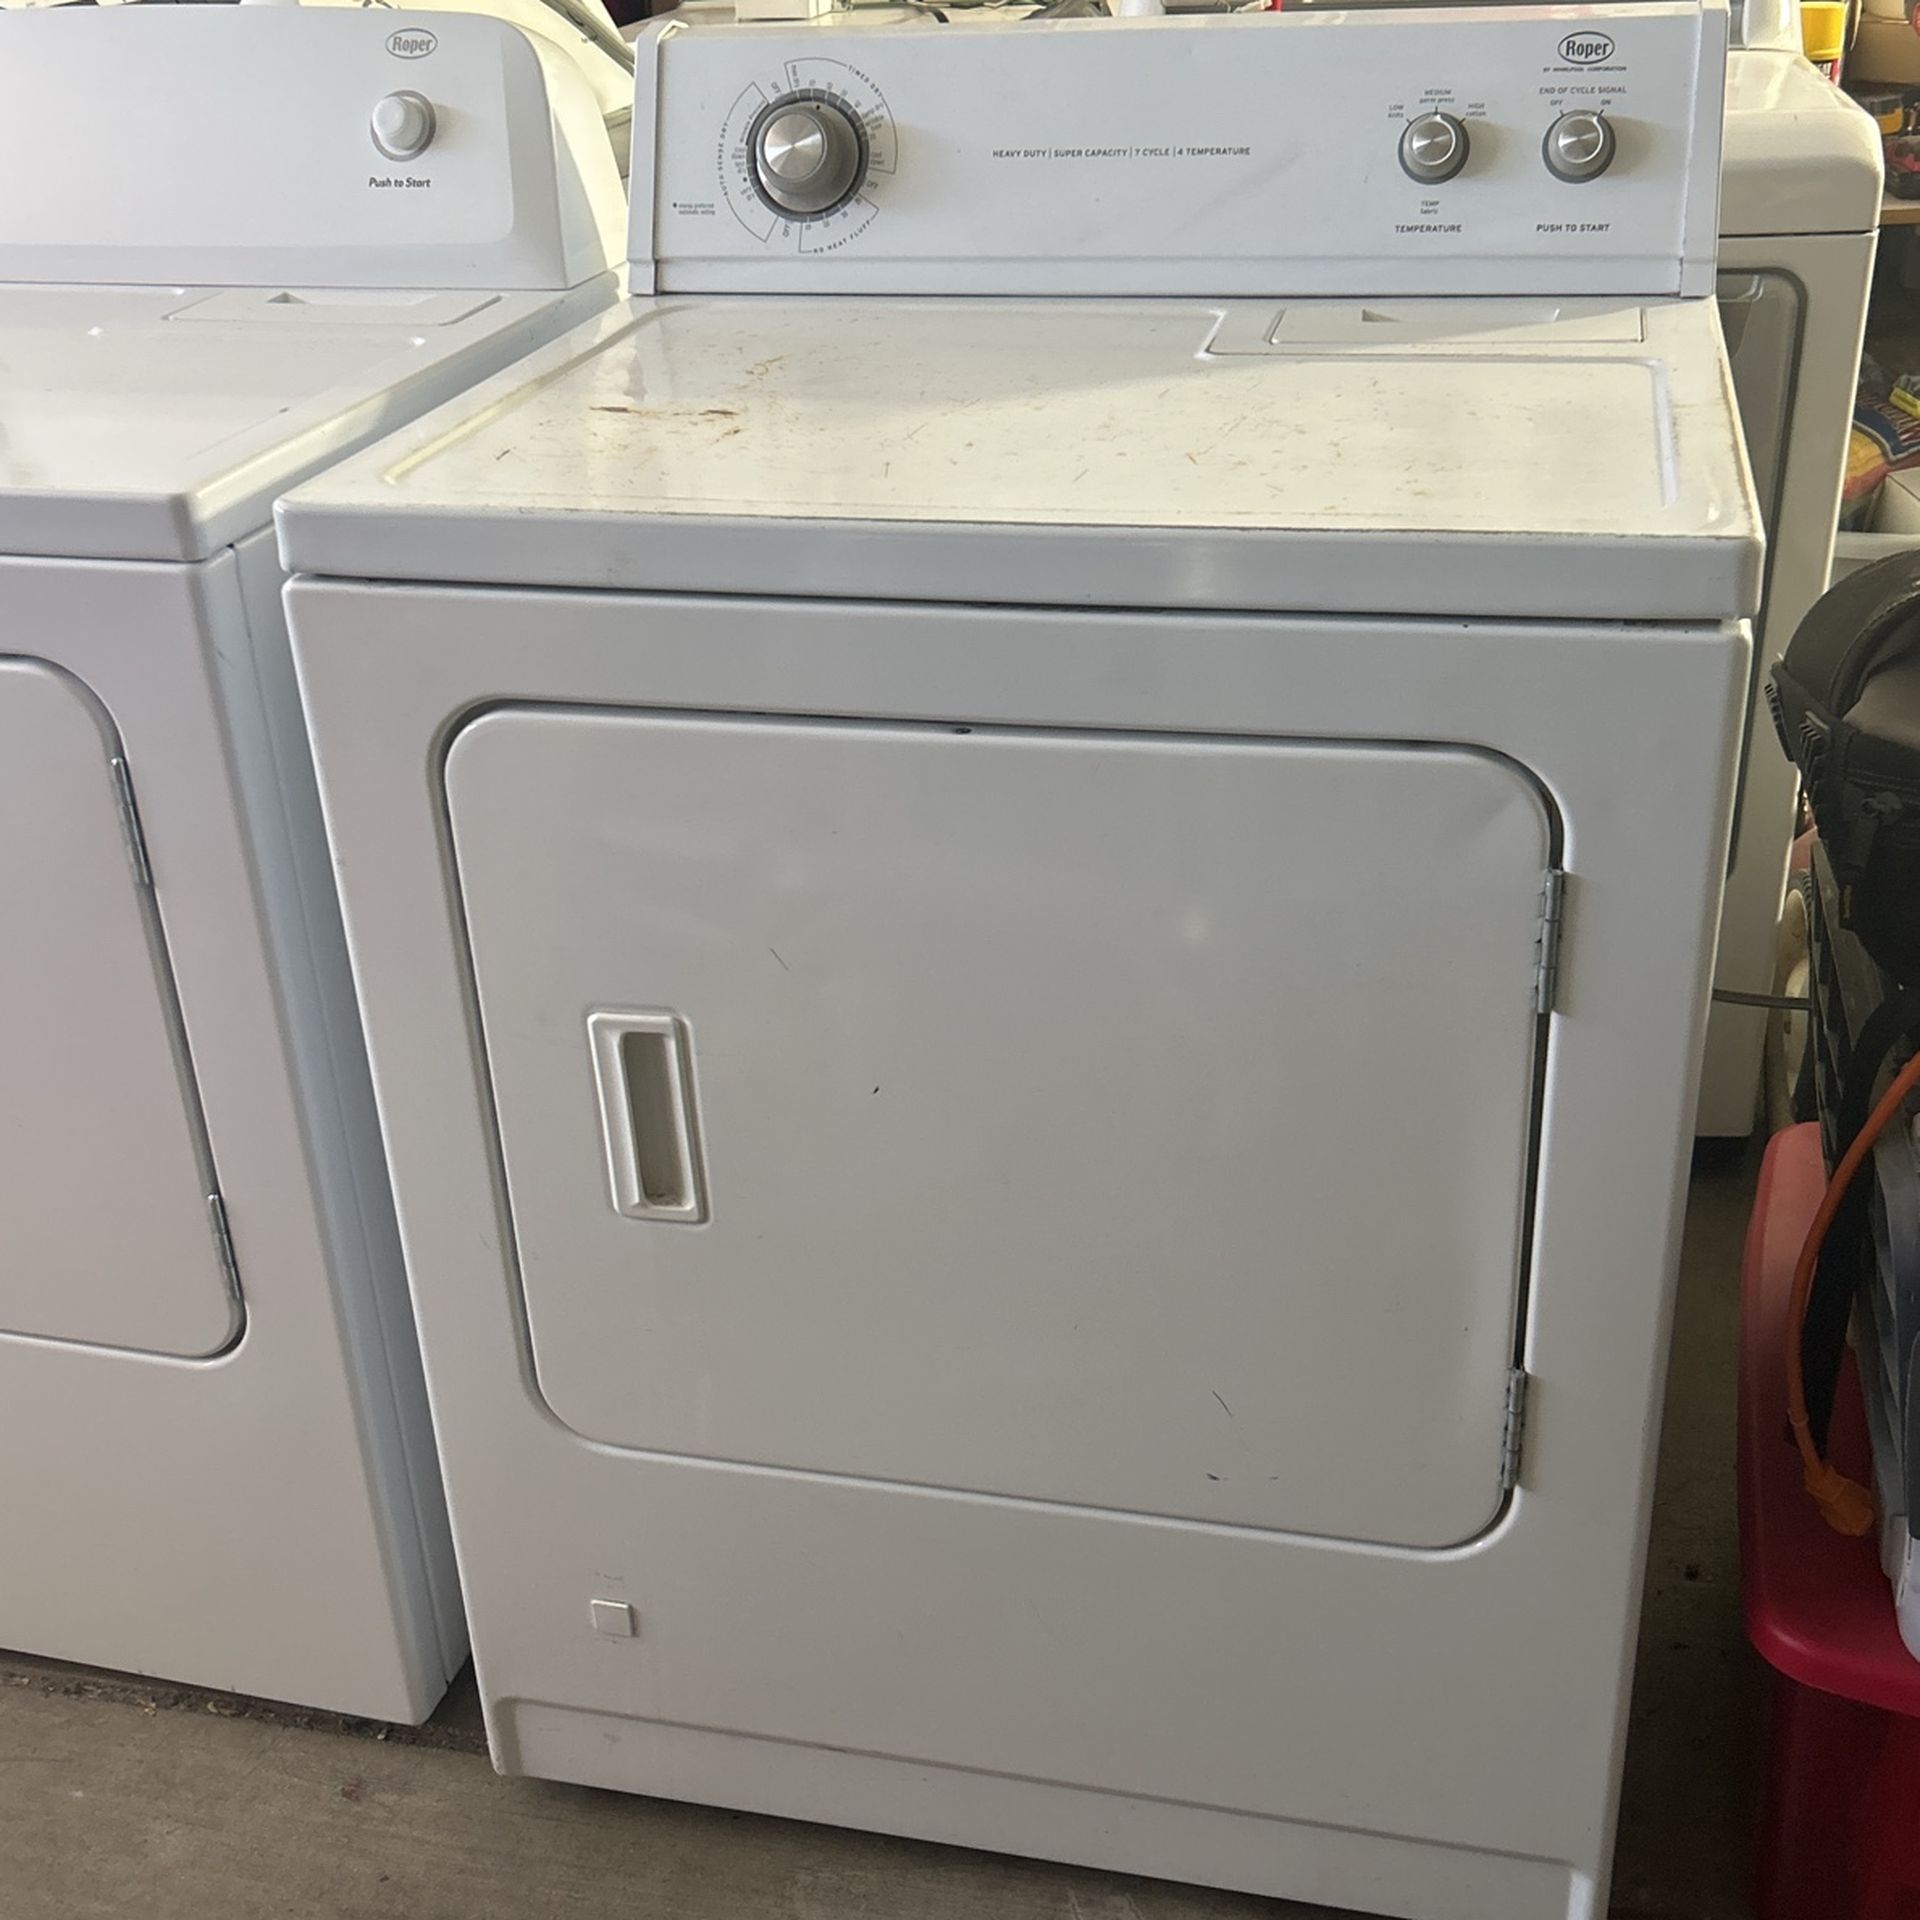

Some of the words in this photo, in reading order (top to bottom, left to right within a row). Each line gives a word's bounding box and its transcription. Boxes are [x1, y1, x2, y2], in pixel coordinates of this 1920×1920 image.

[392, 36, 433, 54] Roper
[1565, 40, 1609, 59] Roper
[848, 65, 870, 84] TIMED
[869, 80, 883, 98] DRY
[1539, 87, 1555, 95] END
[1598, 86, 1627, 94] SIGNAL
[992, 150, 1022, 158] HEAVY
[1023, 149, 1047, 158] DUTY
[1054, 149, 1083, 158] SUPER
[1085, 148, 1128, 157] CAPACITY
[1142, 148, 1170, 157] CYCLE
[1186, 147, 1251, 156] TEMPERATURE
[368, 177, 392, 188] Push
[394, 178, 404, 188] to
[405, 177, 431, 188] Start
[1394, 224, 1462, 233] TEMPERATURE
[1536, 224, 1562, 232] PUSH
[1565, 224, 1577, 232] TO
[1579, 223, 1610, 232] START
[827, 238, 848, 250] HEAT
[850, 220, 871, 240] FLUFF
